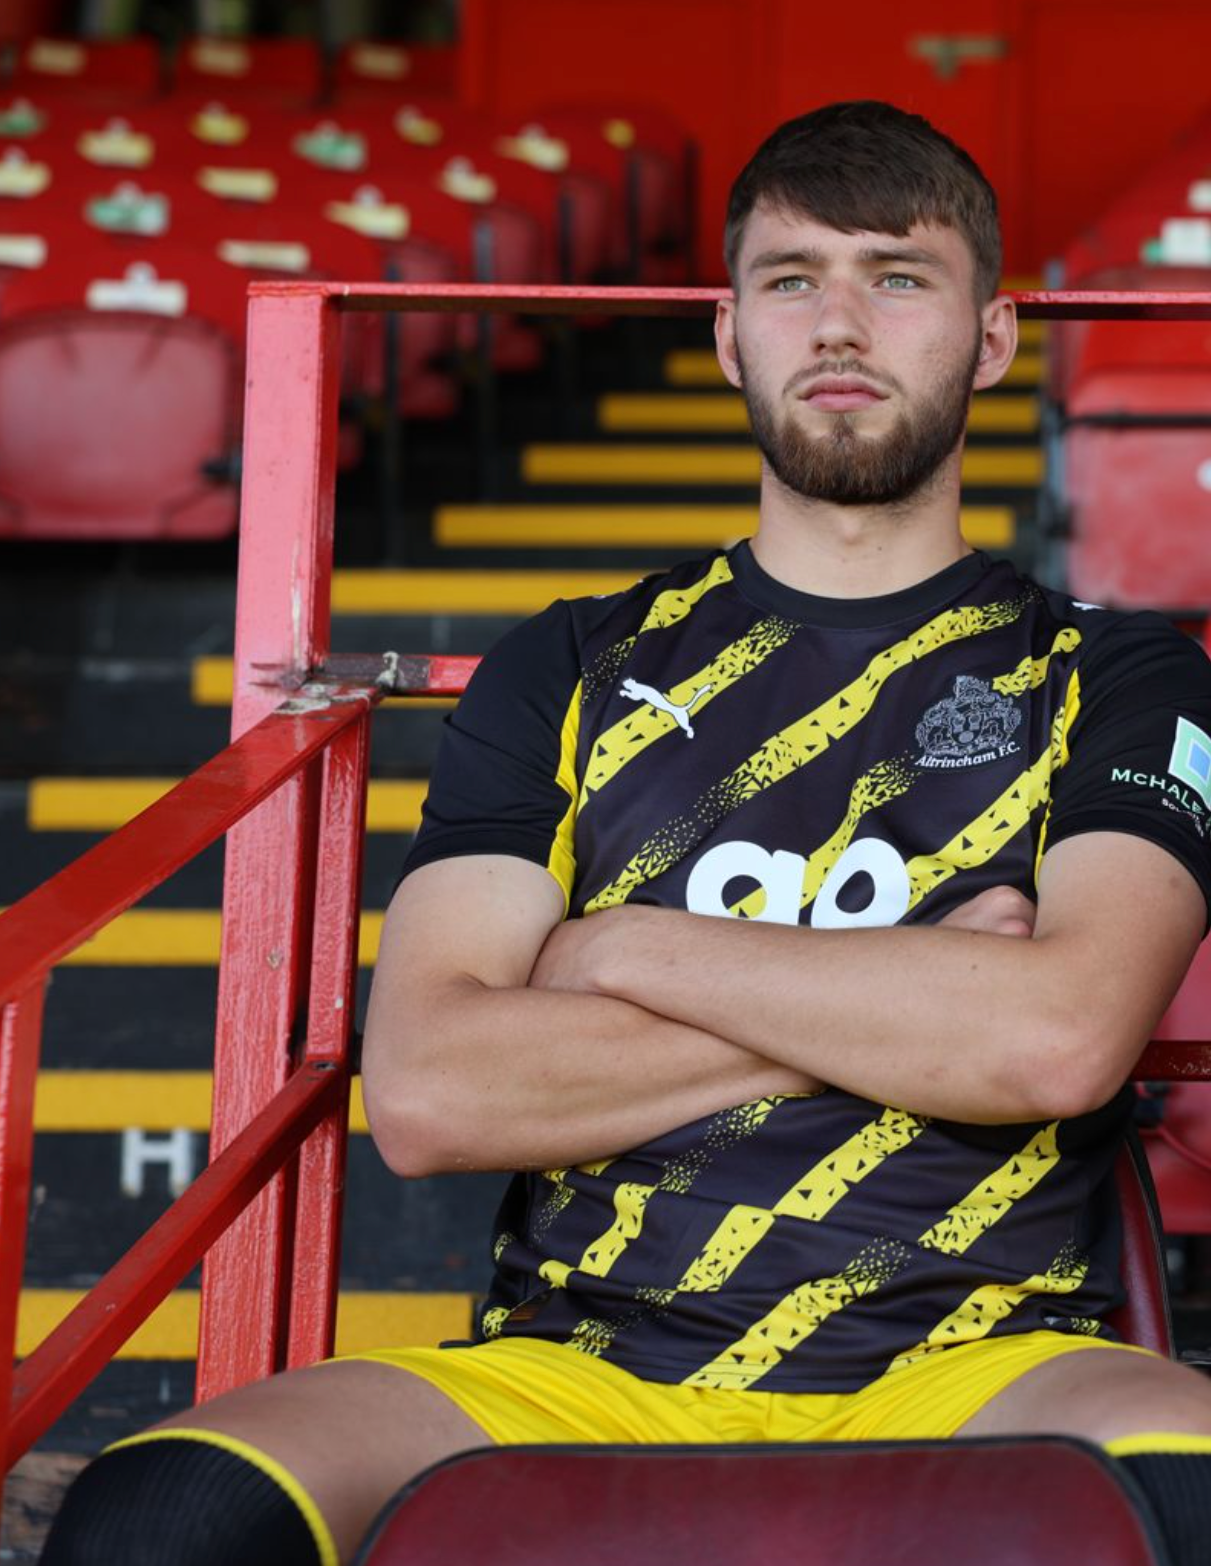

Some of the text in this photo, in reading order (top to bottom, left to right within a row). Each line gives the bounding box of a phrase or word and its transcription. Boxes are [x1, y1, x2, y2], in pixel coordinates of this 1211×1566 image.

[914, 741, 1021, 769] Altrincham F.C.
[120, 1128, 192, 1199] H
